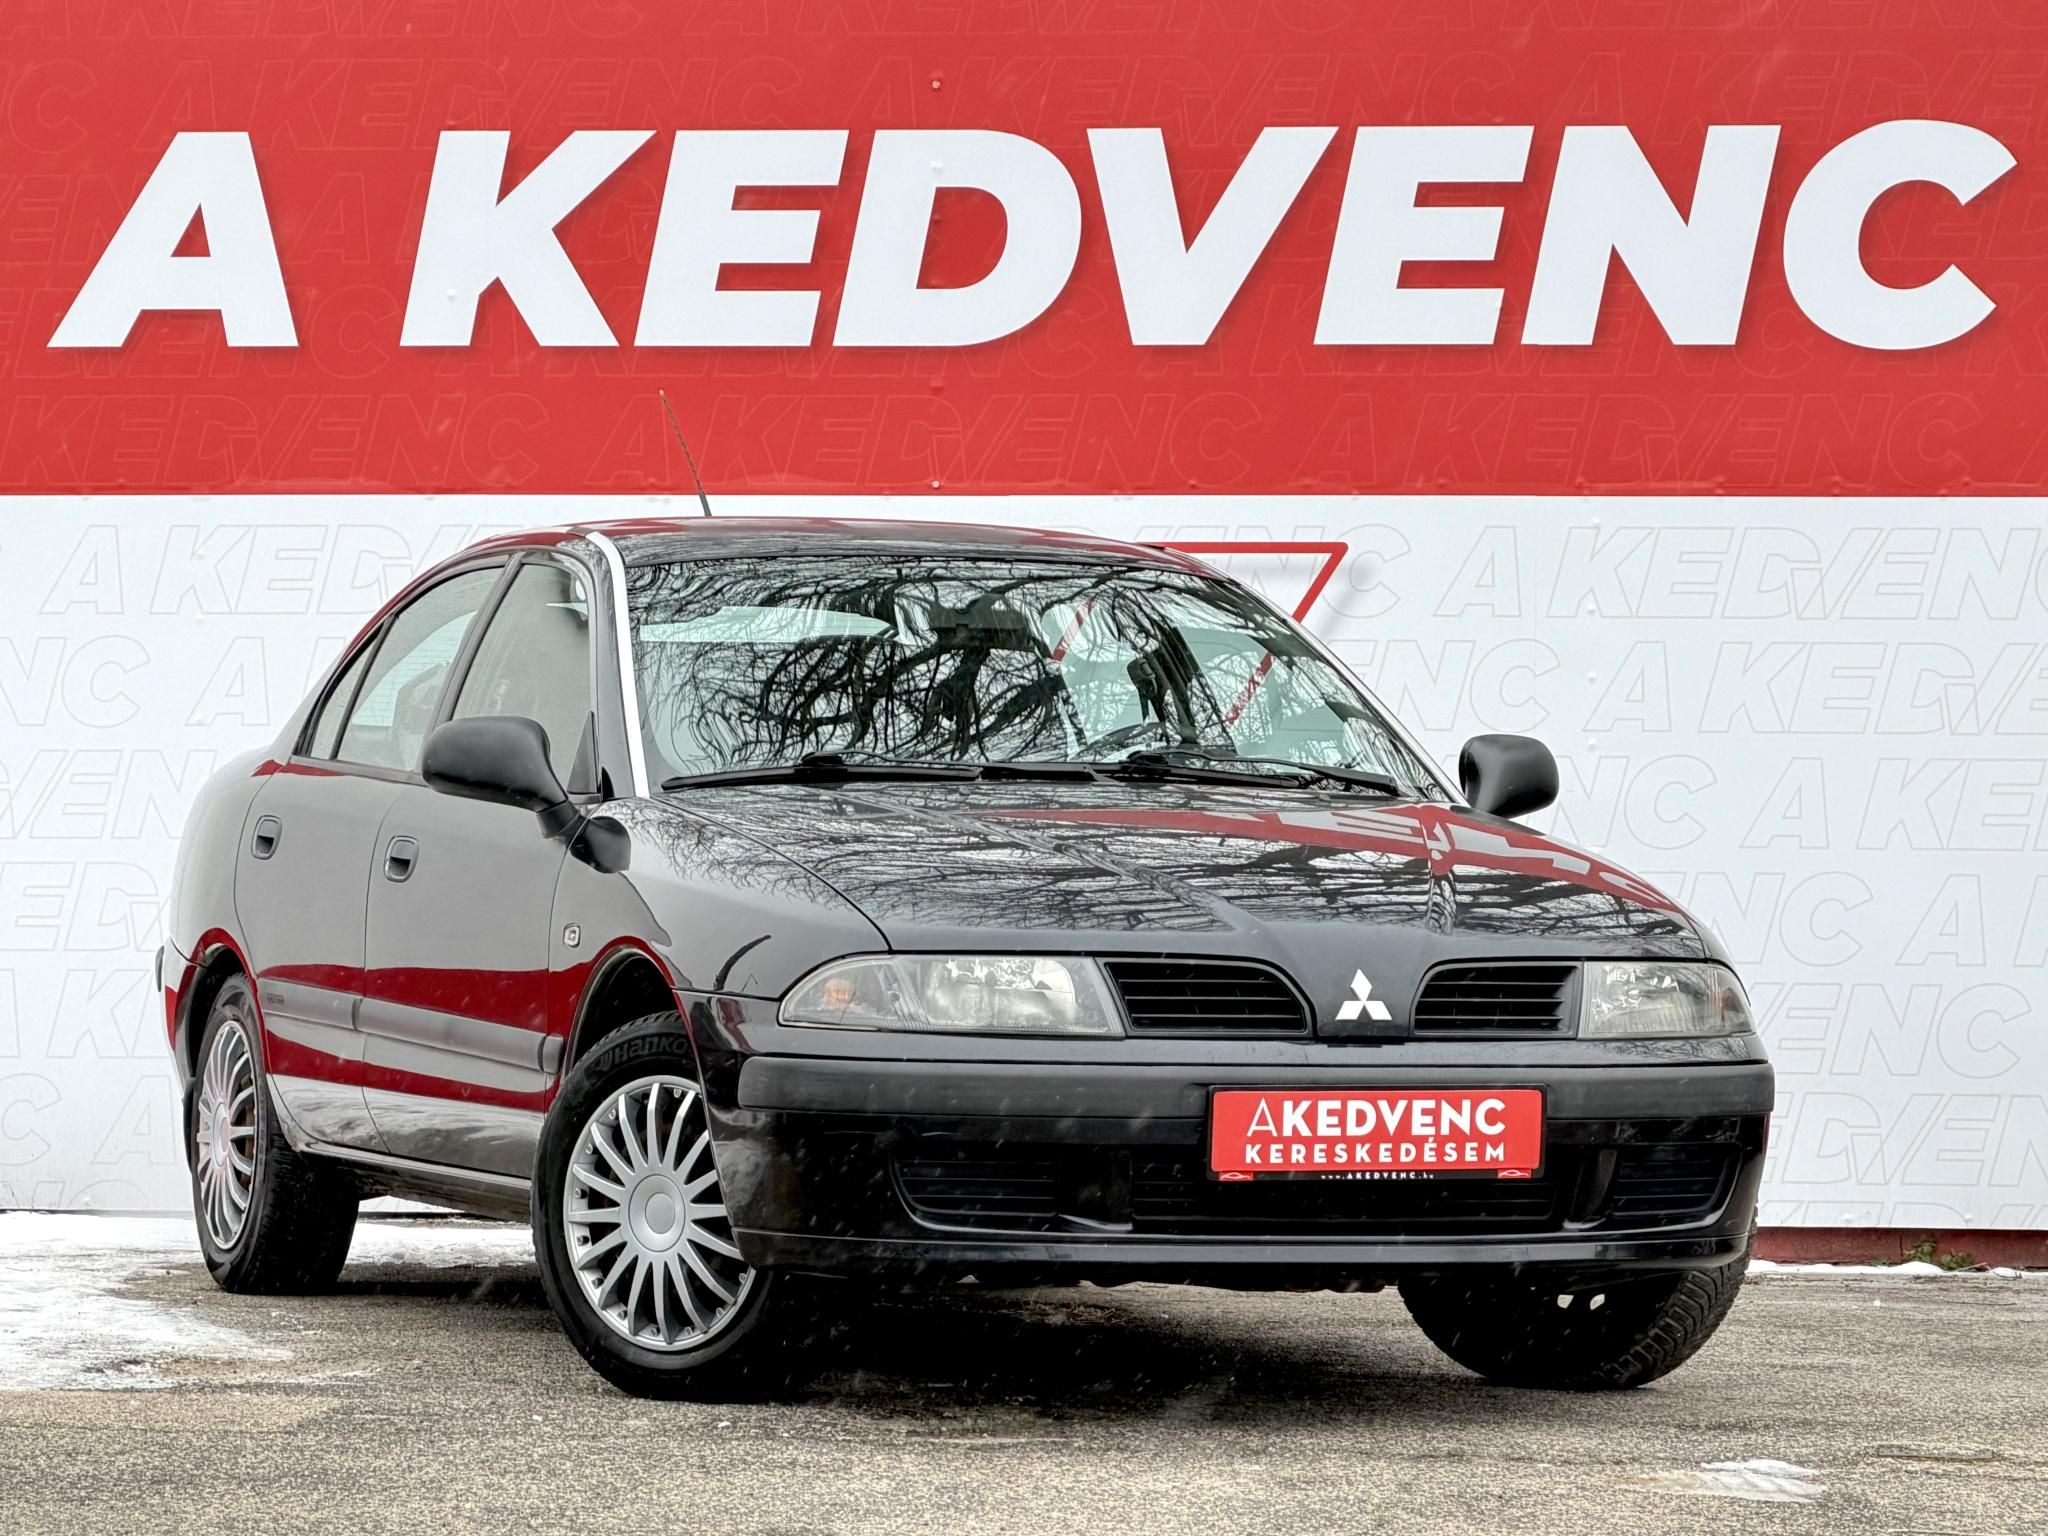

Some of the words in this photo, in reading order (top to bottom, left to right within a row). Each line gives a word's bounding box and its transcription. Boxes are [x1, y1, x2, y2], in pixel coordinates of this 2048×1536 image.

[132, 59, 216, 151] A
[48, 131, 299, 348] A
[400, 119, 2018, 351] KEDVENC
[584, 393, 672, 486] A
[699, 392, 1265, 489] KEDVENC
[1289, 392, 1377, 486] A
[1402, 391, 1983, 489] KEDVENC
[38, 524, 125, 615] A
[1431, 524, 1523, 618] A
[1545, 525, 2048, 621] KEDVEN
[184, 636, 271, 727] A
[1581, 639, 1673, 734] A
[1738, 756, 1830, 850] A
[1893, 873, 1988, 967] A
[89, 1074, 178, 1165] A
[1245, 1137, 1505, 1164] KERESKEDÉSEM
